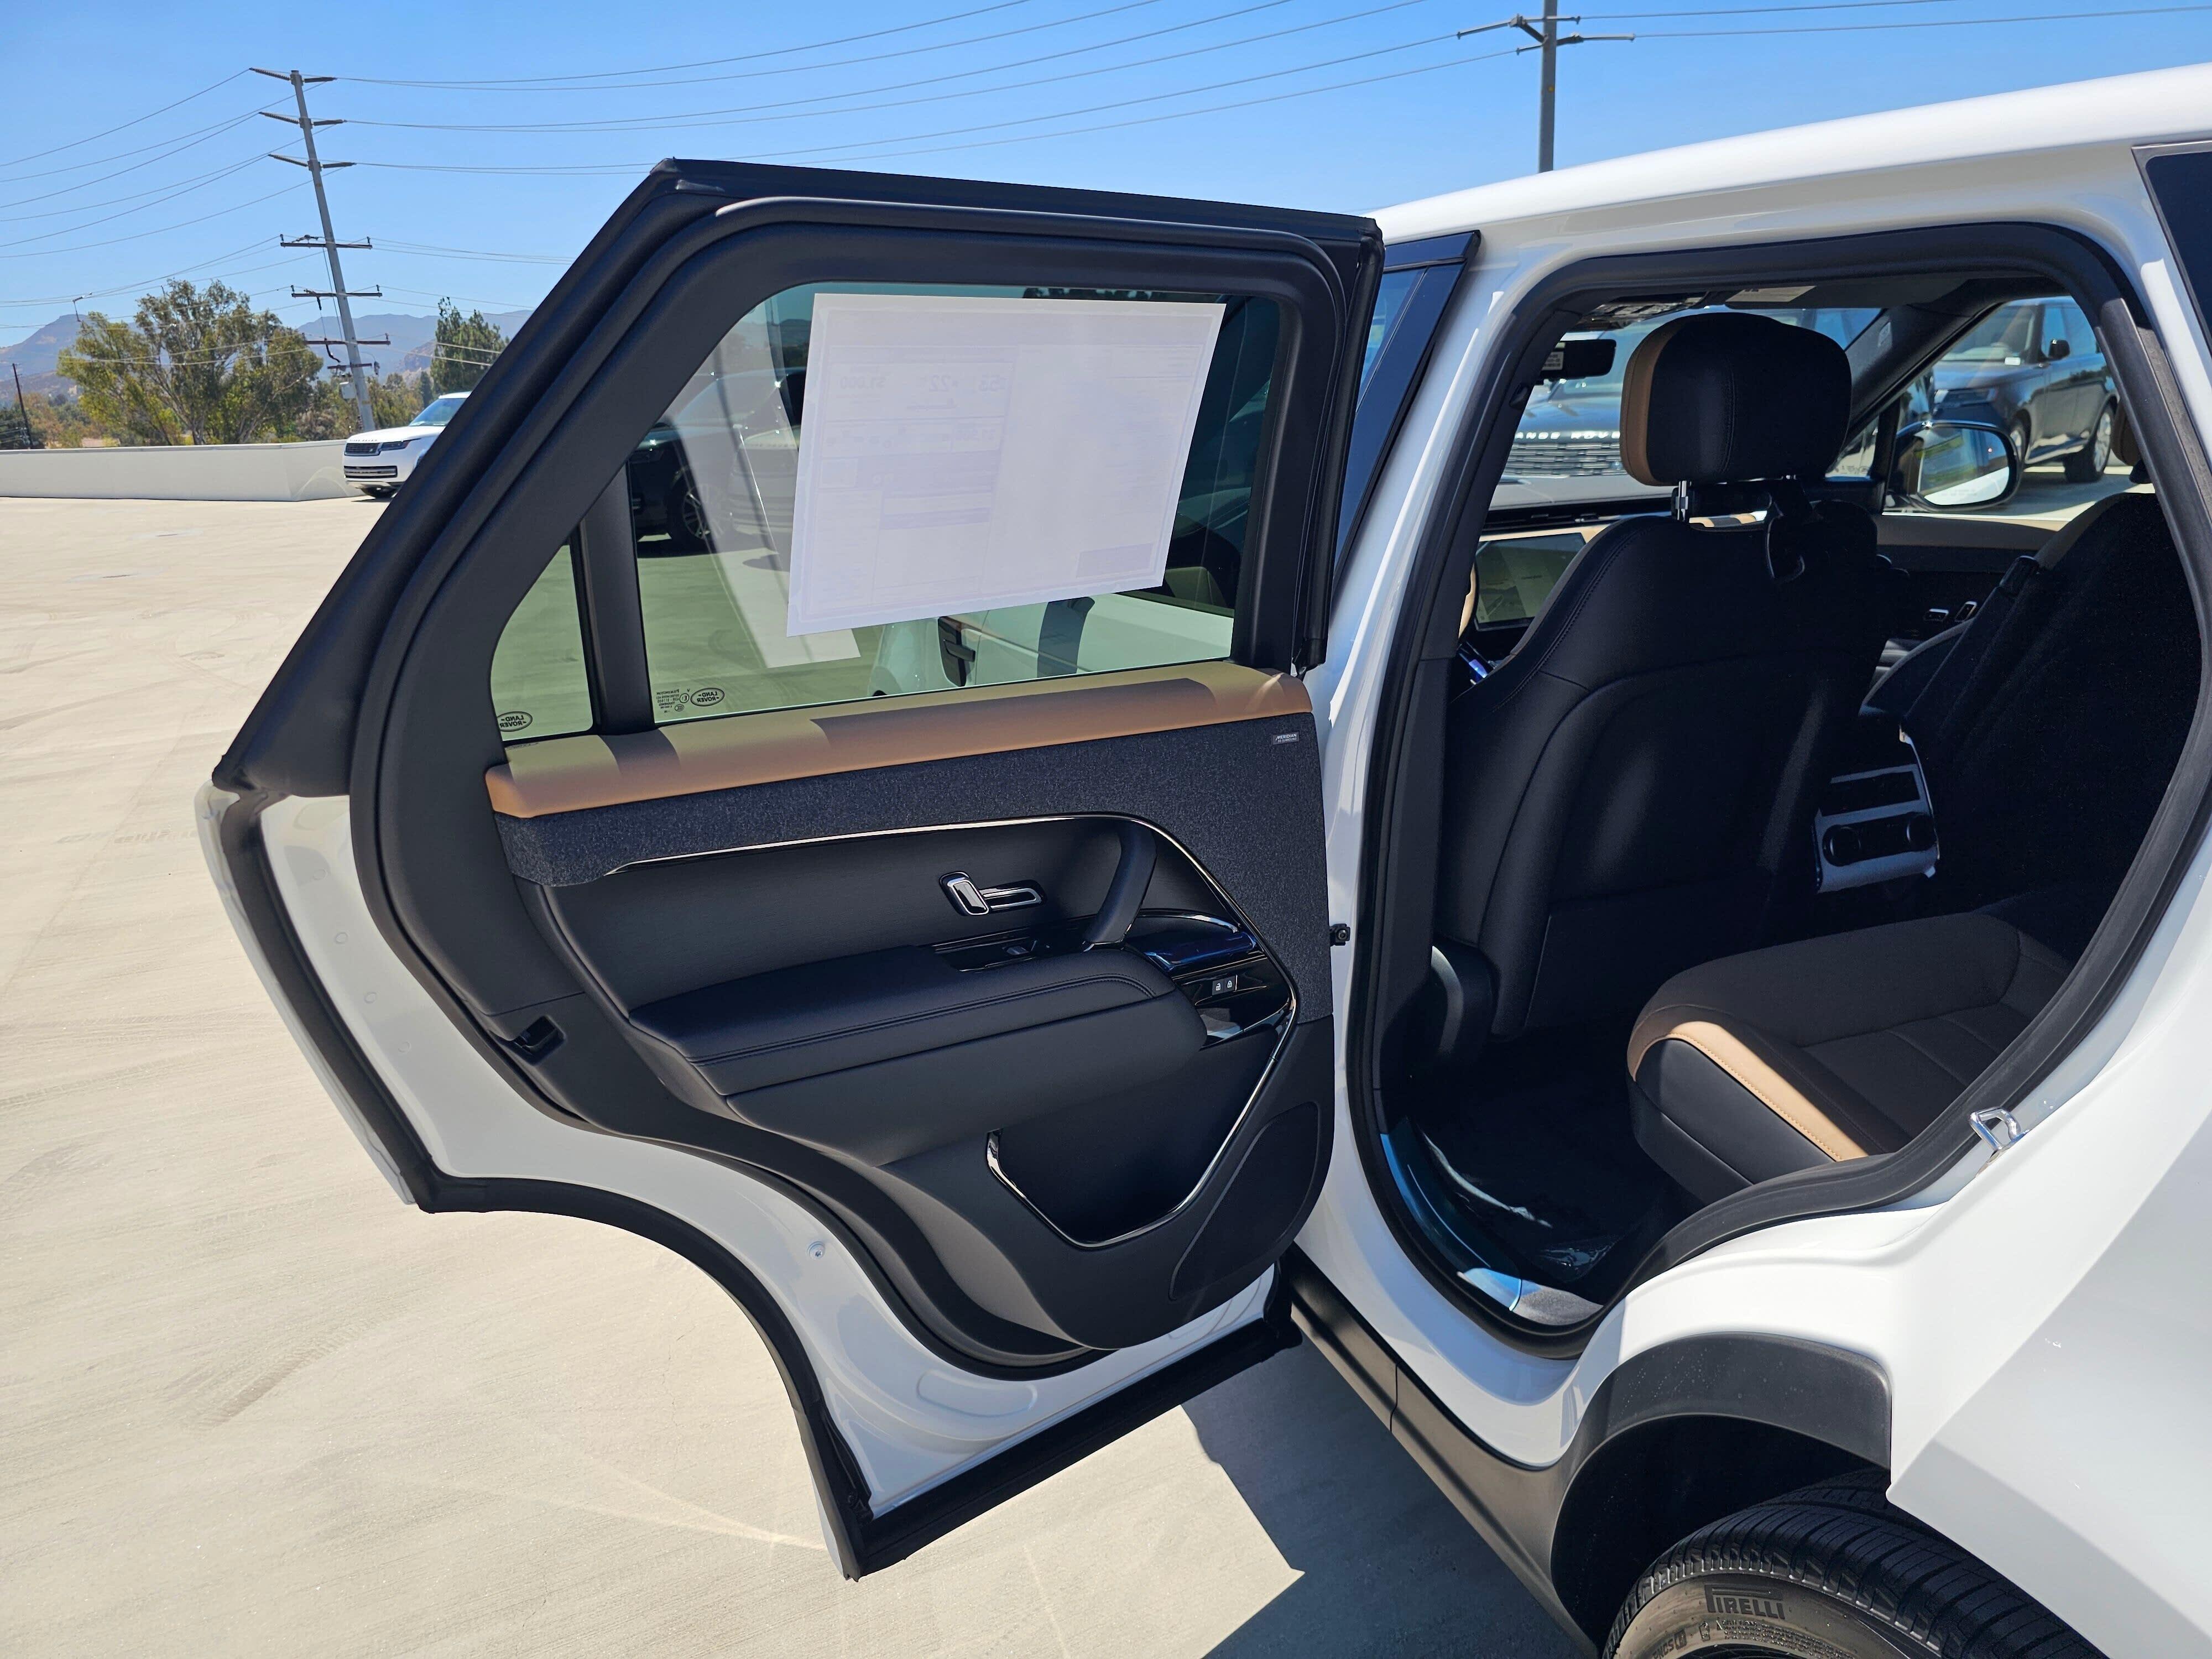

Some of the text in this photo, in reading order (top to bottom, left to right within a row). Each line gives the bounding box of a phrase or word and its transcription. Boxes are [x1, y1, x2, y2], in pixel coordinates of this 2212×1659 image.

[1515, 431, 1620, 440] ANGE ROVE
[1704, 1584, 1786, 1620] PIRELLI
